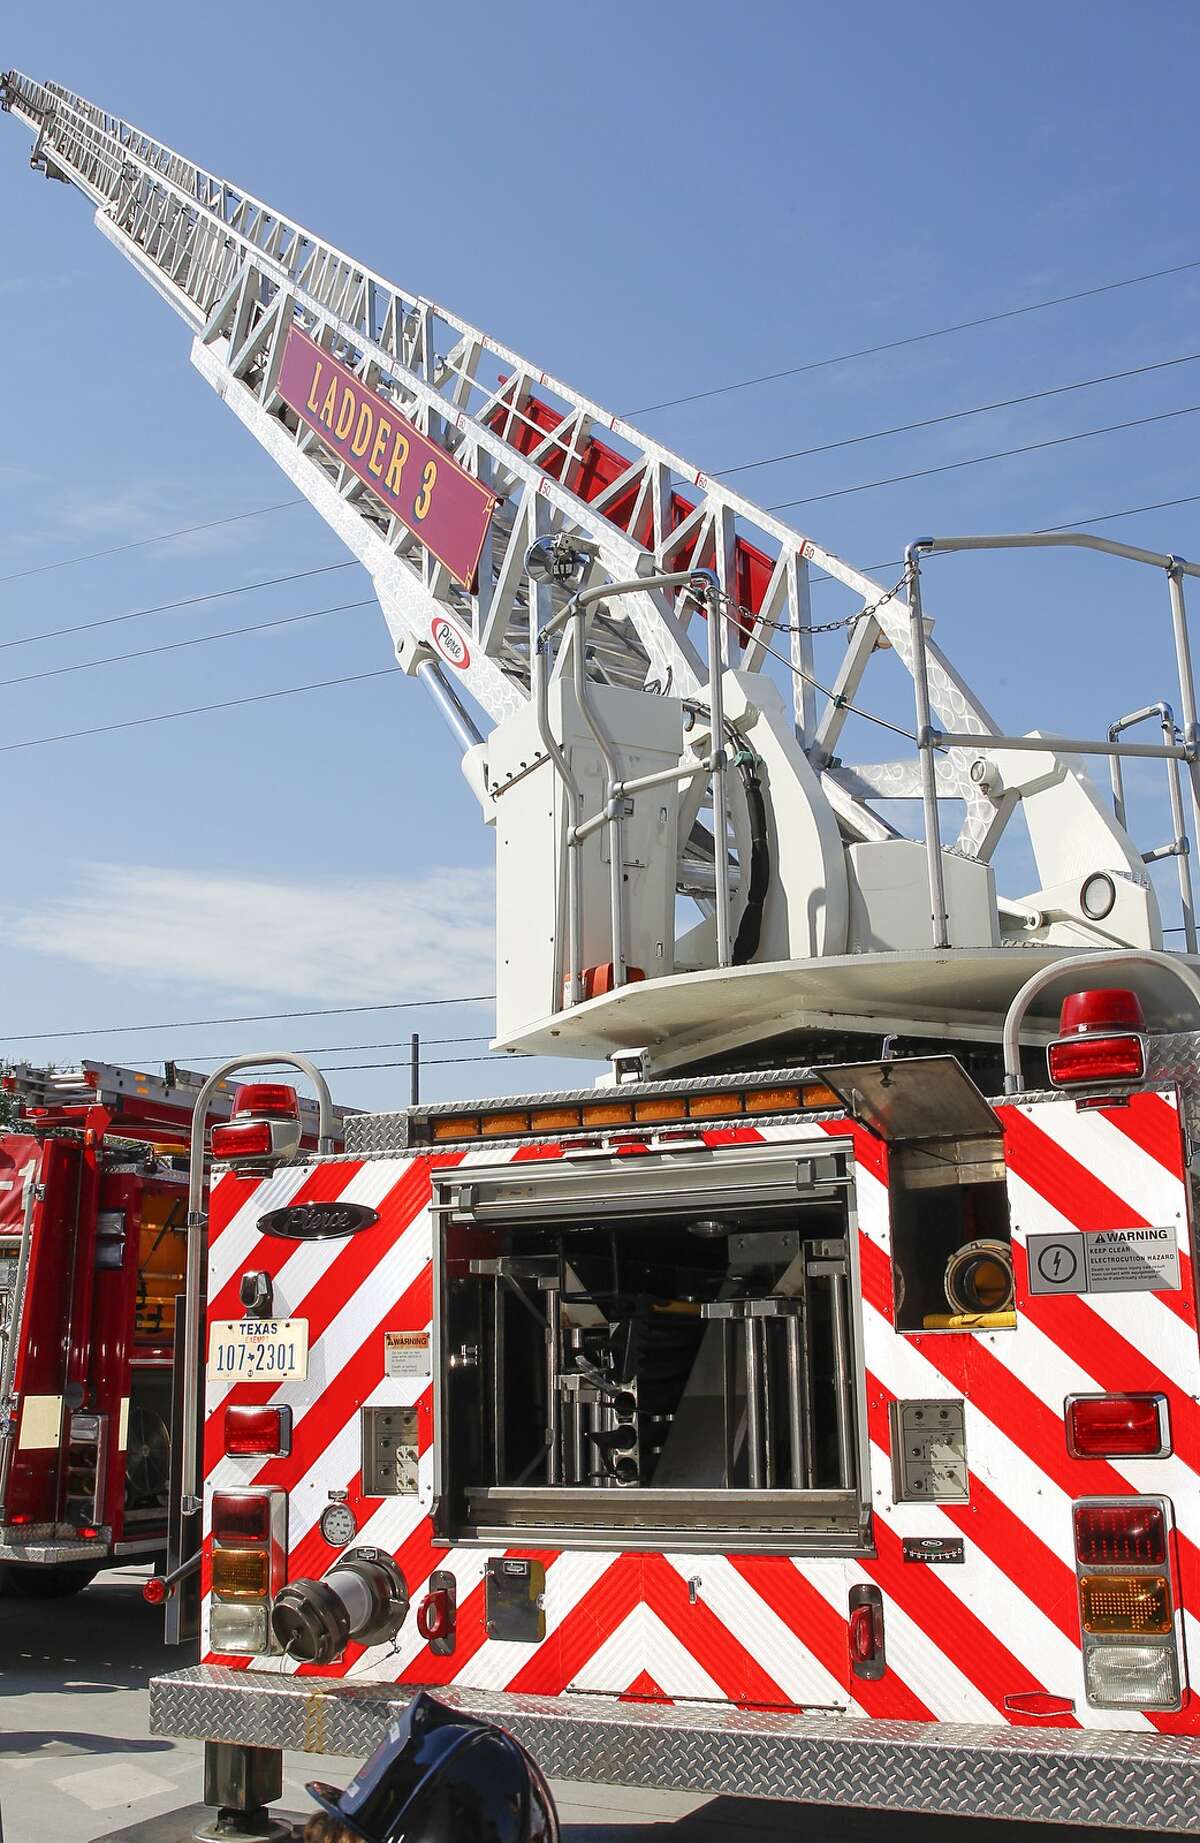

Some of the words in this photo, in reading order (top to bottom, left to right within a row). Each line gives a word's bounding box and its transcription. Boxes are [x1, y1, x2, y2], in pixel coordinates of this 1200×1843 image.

[306, 361, 410, 497] LADDER
[414, 460, 438, 520] 3
[438, 624, 461, 658] Pierce
[287, 1207, 352, 1231] Pierce
[1106, 1229, 1167, 1242] WARNING
[1090, 1255, 1146, 1265] ELECTROCUTION
[1147, 1253, 1175, 1261] HAZARD
[239, 1322, 278, 1336] TEXAS
[393, 1337, 427, 1346] WARNING
[217, 1344, 246, 1371] 107
[256, 1343, 296, 1371] 2301
